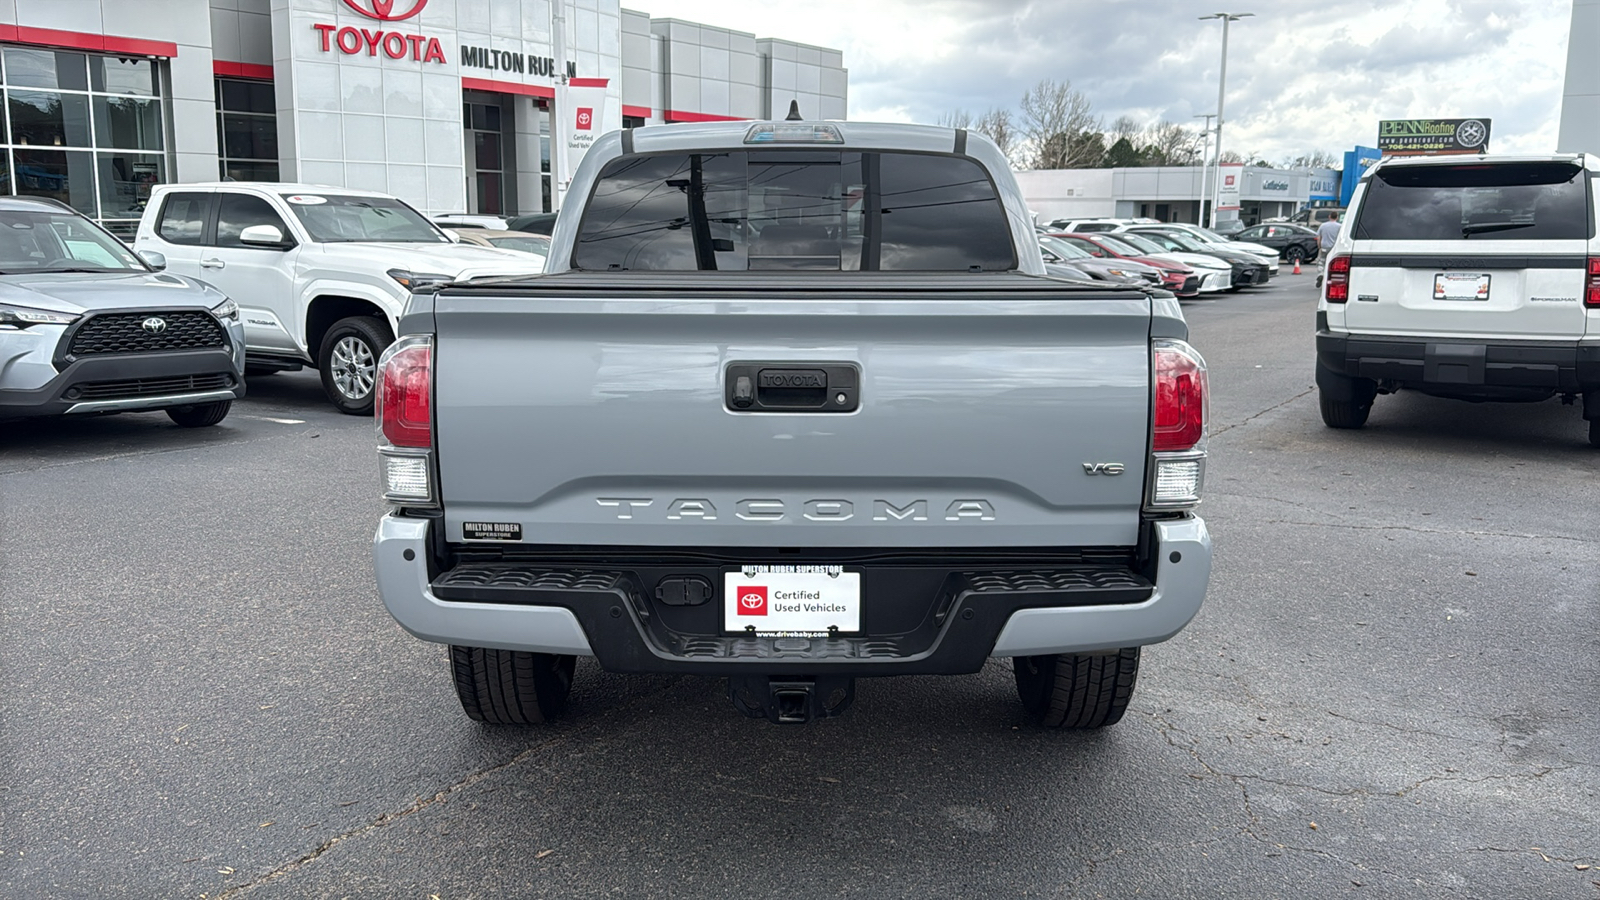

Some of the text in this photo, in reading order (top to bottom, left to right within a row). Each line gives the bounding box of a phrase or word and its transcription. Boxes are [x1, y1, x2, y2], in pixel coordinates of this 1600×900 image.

[313, 23, 447, 64] TOYOTA
[460, 45, 524, 74] MILTON
[1381, 121, 1425, 134] PENN
[1425, 122, 1455, 136] Roofing
[764, 374, 821, 387] TOYOTA
[1082, 462, 1124, 476] V6
[596, 497, 996, 522] TACOMA
[465, 523, 519, 532] MILTON RUBEN
[741, 565, 843, 573] MILTON RUBEN SUPERSTORE
[774, 590, 820, 600] Certified
[774, 603, 847, 612] Used Vehicles
